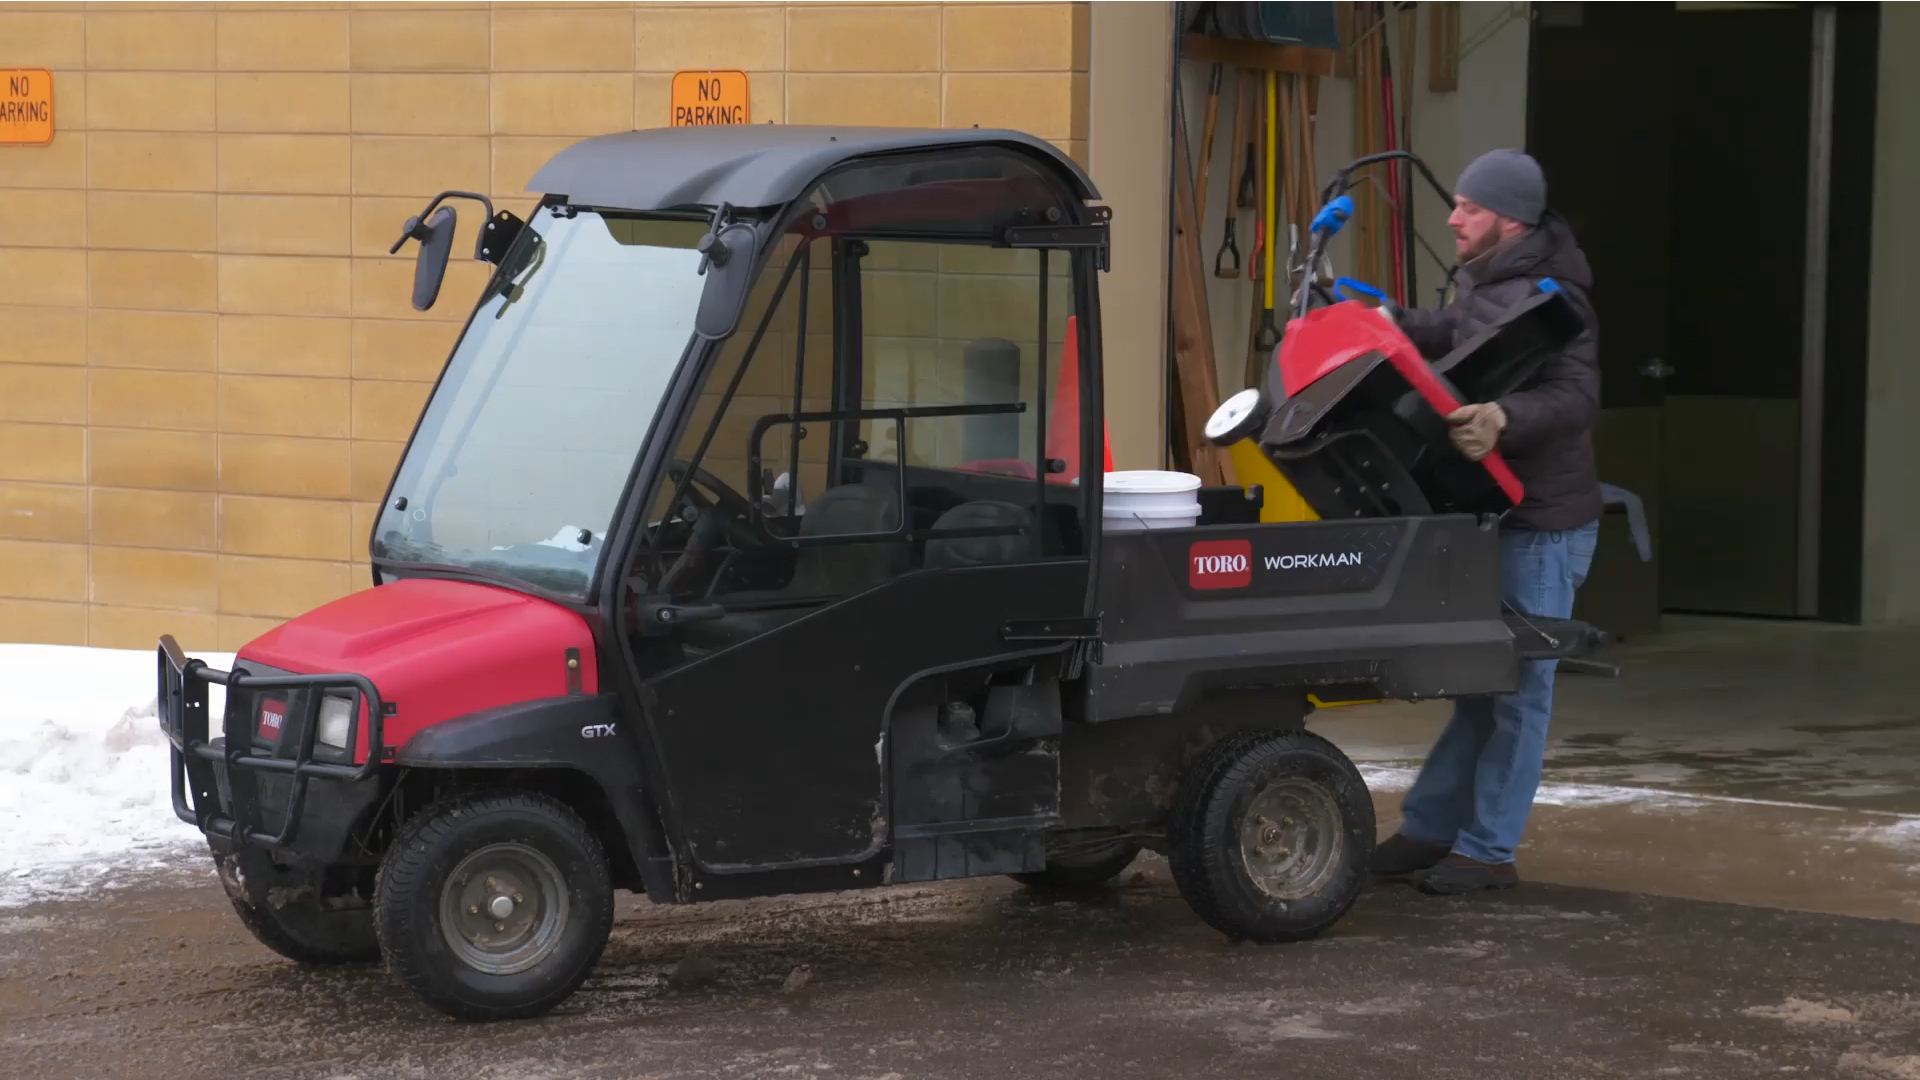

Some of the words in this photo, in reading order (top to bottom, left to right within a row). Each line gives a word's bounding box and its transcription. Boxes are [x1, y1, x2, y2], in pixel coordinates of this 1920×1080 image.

[10, 76, 29, 97] NO
[698, 78, 721, 101] NO
[0, 101, 48, 122] ARKING
[676, 105, 742, 127] PARKING
[1194, 554, 1247, 575] TORO
[1264, 552, 1362, 570] WORKMAN
[581, 722, 617, 738] GTX
